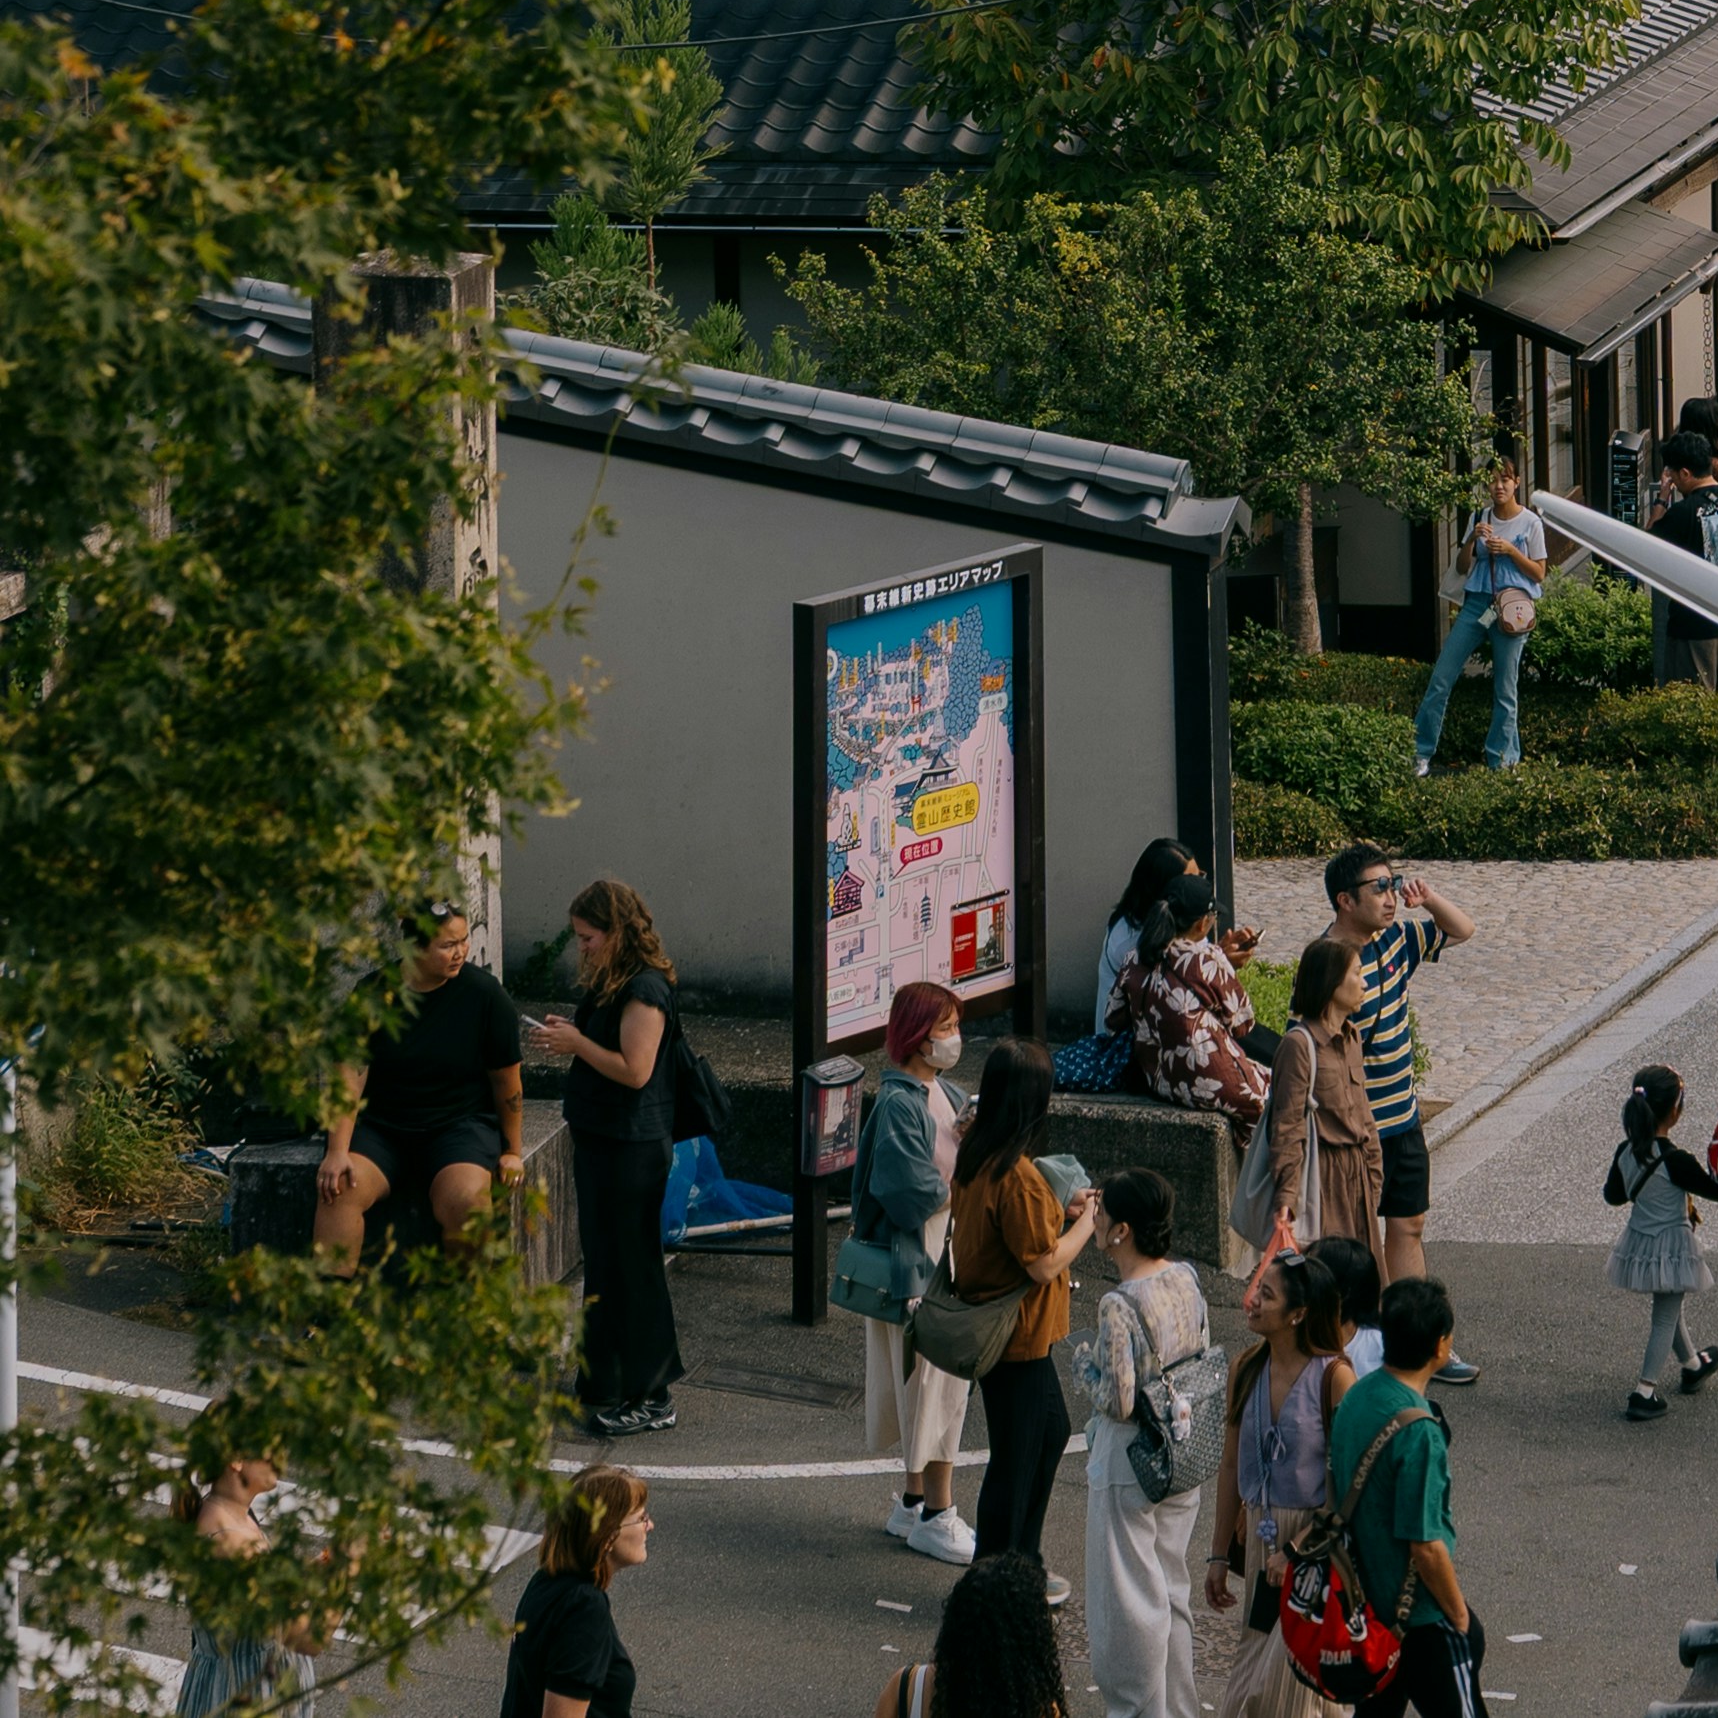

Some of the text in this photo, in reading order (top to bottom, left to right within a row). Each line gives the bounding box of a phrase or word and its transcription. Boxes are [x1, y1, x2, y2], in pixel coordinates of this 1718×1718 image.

[864, 560, 1004, 614] 幕末維新史跡エリアマップ
[916, 799, 976, 830] 霊山歴史館
[904, 839, 940, 862] 現在位置
